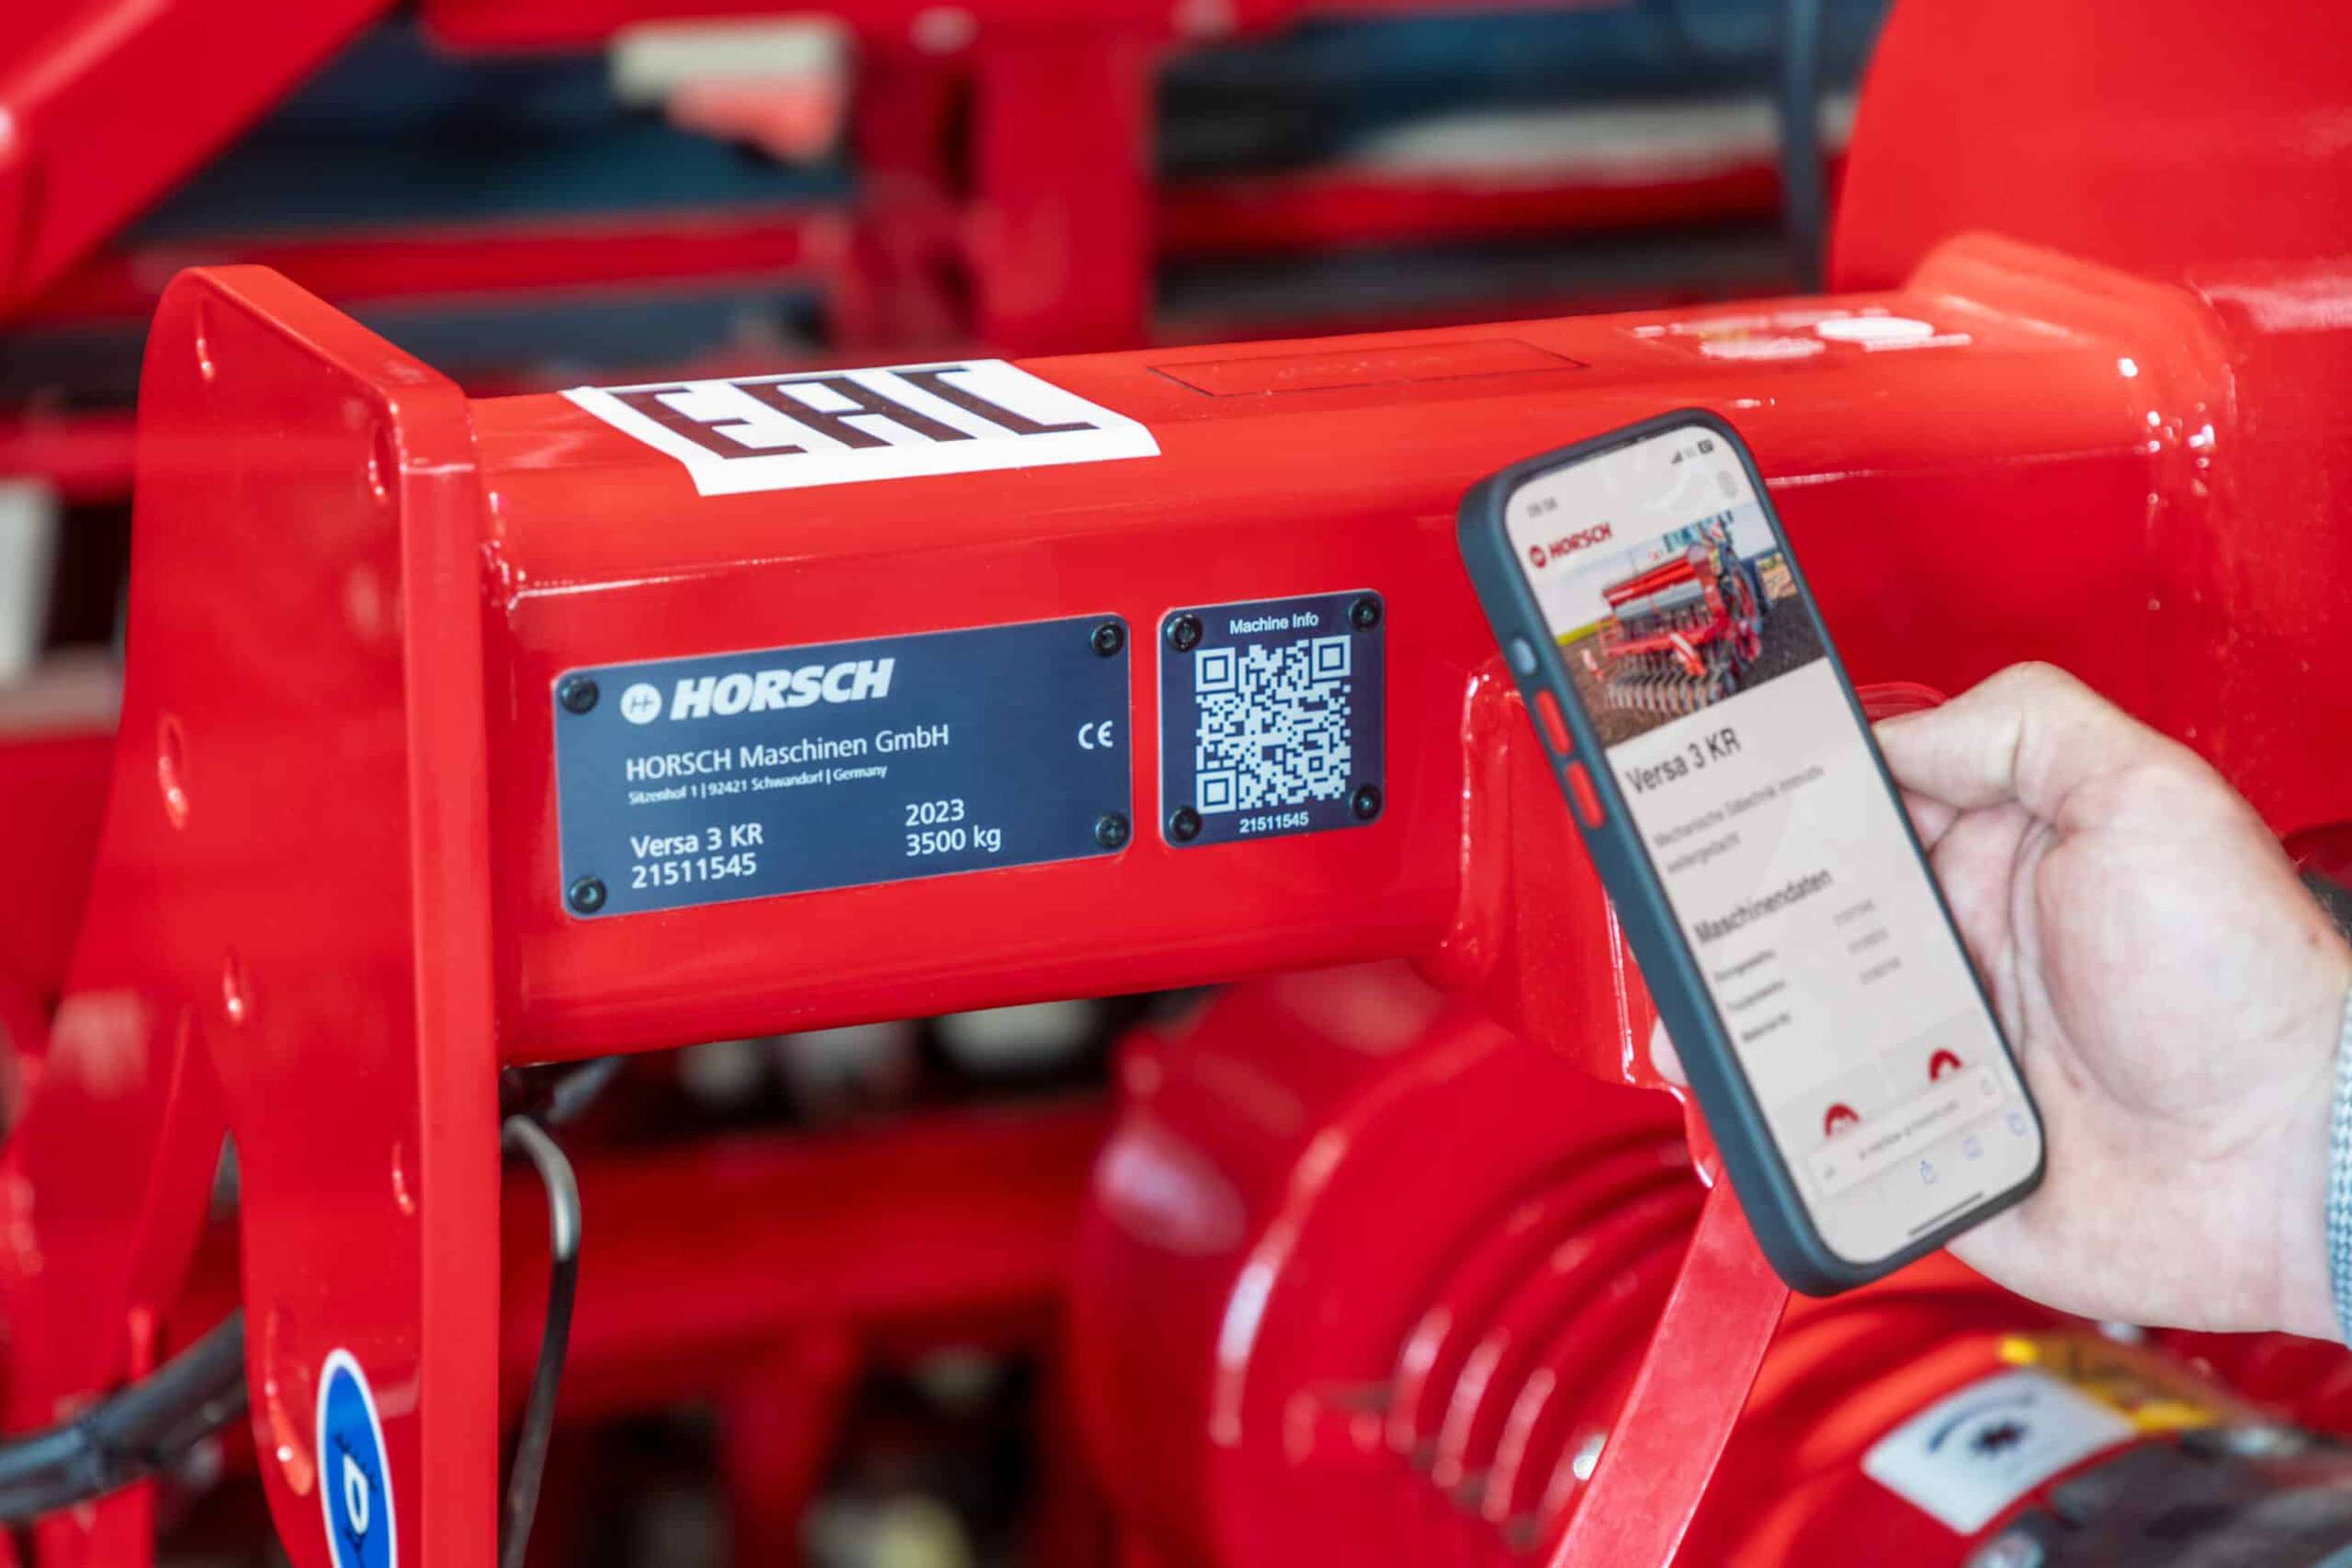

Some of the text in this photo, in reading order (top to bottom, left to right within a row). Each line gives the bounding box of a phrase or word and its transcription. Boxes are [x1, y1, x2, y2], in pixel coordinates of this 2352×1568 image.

[1230, 611, 1320, 635] Machine Info
[669, 658, 895, 720] HORSCH
[626, 724, 949, 782] HORSCH Maschinen GmbH
[1625, 727, 1742, 794] Versa 3 KR
[628, 785, 688, 805] Sitzenhof
[691, 784, 697, 798] 1
[707, 778, 748, 796] 92421
[751, 769, 824, 792] Schwandorf
[832, 765, 888, 782] Germany
[905, 799, 965, 827] 2023
[1239, 811, 1310, 835] 21511545
[630, 822, 764, 859] Versa 3 KR
[905, 825, 1002, 858] 3500 kg
[632, 852, 757, 889] 21511545
